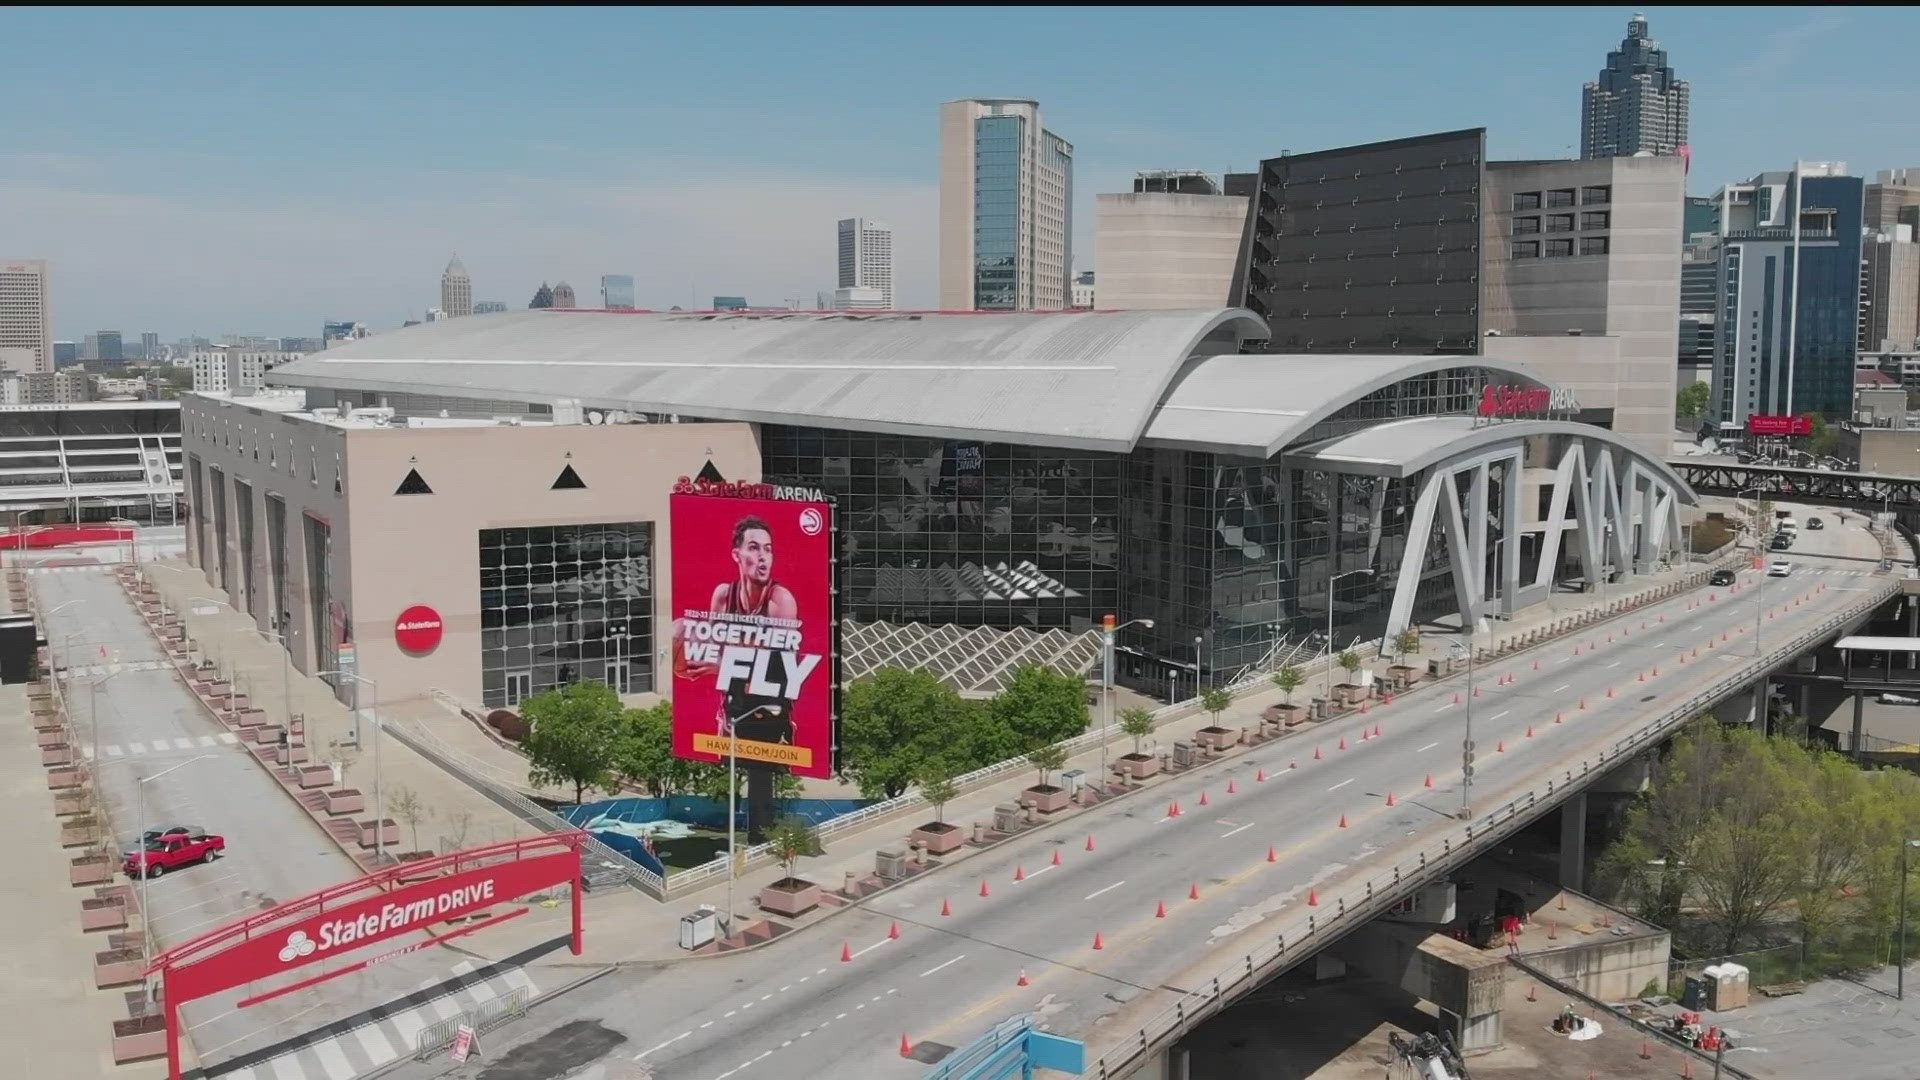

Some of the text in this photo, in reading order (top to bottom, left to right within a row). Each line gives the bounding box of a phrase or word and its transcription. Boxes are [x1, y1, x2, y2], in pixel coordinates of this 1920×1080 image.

[1549, 389, 1576, 410] ARENA
[775, 486, 823, 502] ARENA
[683, 619, 803, 651] TOGETHER
[684, 640, 823, 700] WE FLY
[438, 879, 495, 915] DRIVE
